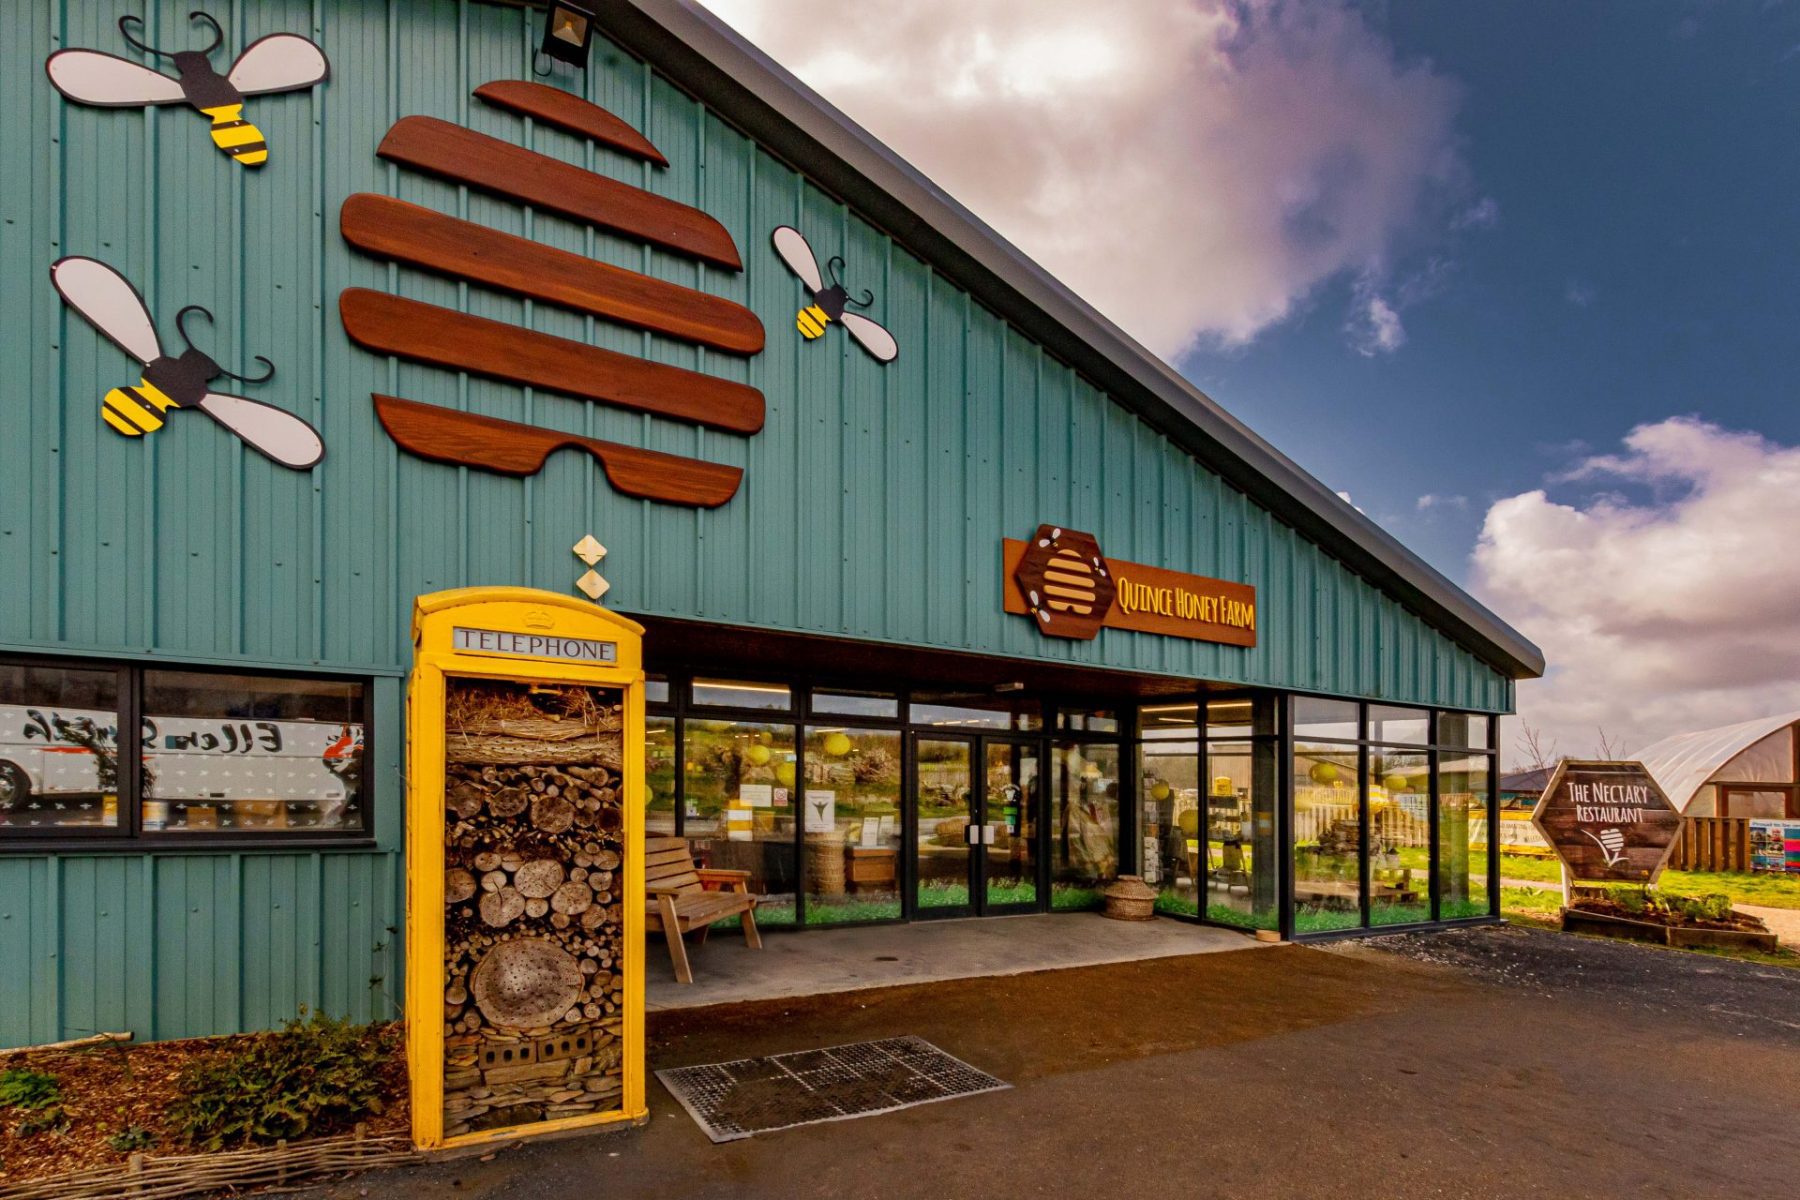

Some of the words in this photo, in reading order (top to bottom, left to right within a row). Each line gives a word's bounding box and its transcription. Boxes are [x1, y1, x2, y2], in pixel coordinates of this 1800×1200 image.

[1117, 577, 1174, 615] QUINCE
[1175, 587, 1218, 623] HONEY
[1219, 595, 1254, 631] FARM
[459, 630, 611, 661] TELEPHONE
[1567, 782, 1591, 803] THE
[1592, 782, 1648, 804] NECTARY
[1576, 804, 1644, 823] RESTAURANT
